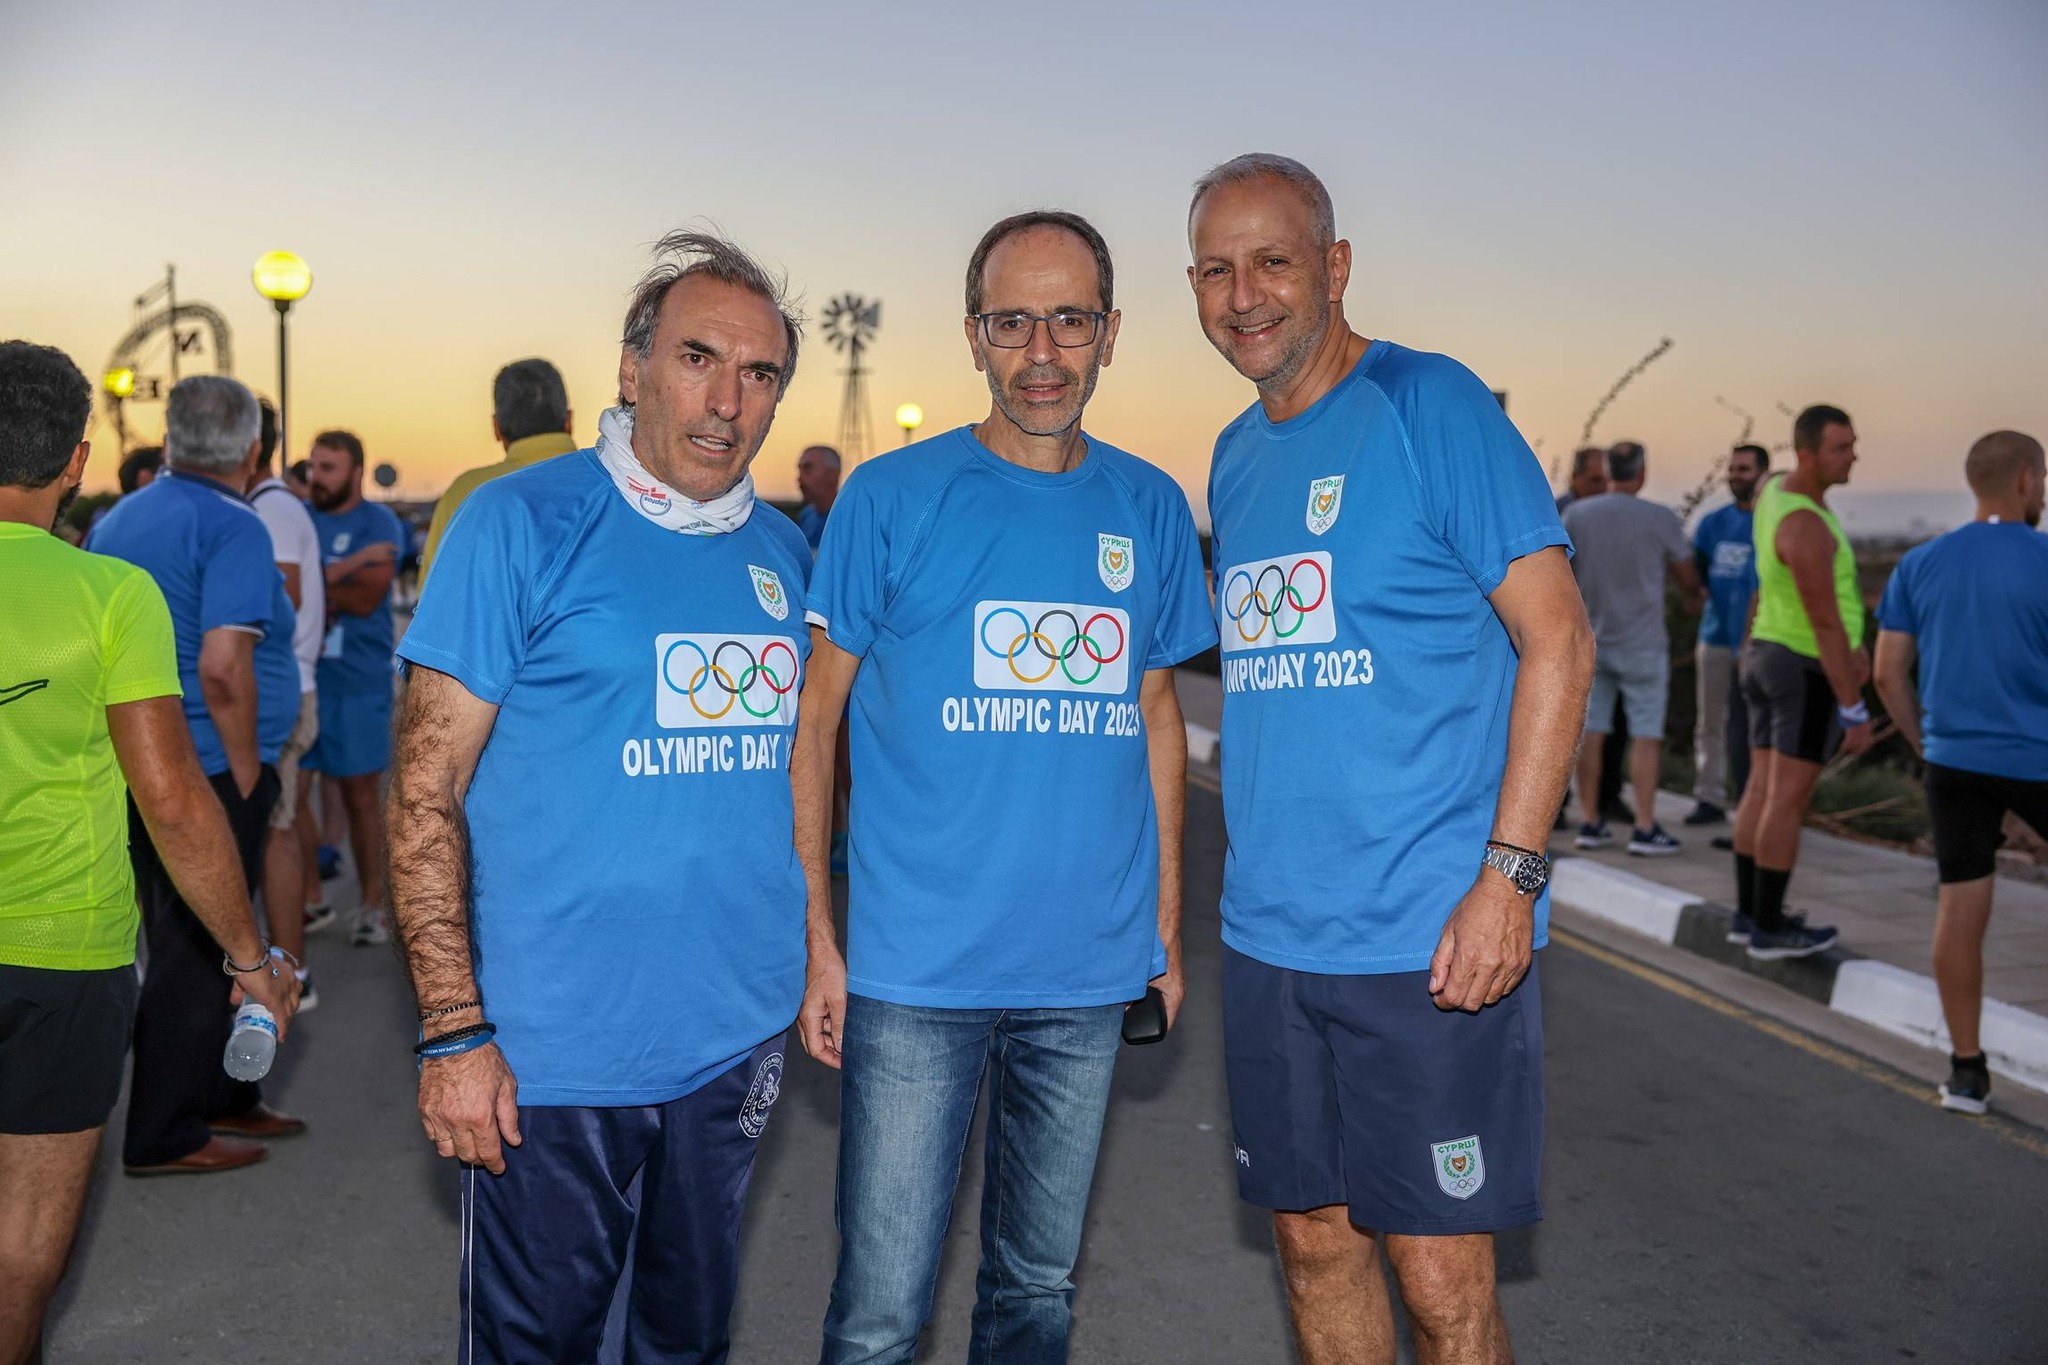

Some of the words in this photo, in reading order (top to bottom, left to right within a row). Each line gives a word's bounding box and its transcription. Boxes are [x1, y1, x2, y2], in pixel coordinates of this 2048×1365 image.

[1101, 537, 1130, 548] CYPRUS
[1313, 648, 1374, 687] 2023
[942, 697, 1051, 733] OLYMPIC
[1058, 699, 1100, 734] DAY
[622, 735, 735, 777] OLYMPIC
[741, 734, 781, 770] DAY
[1437, 1139, 1476, 1154] CYPRUS
